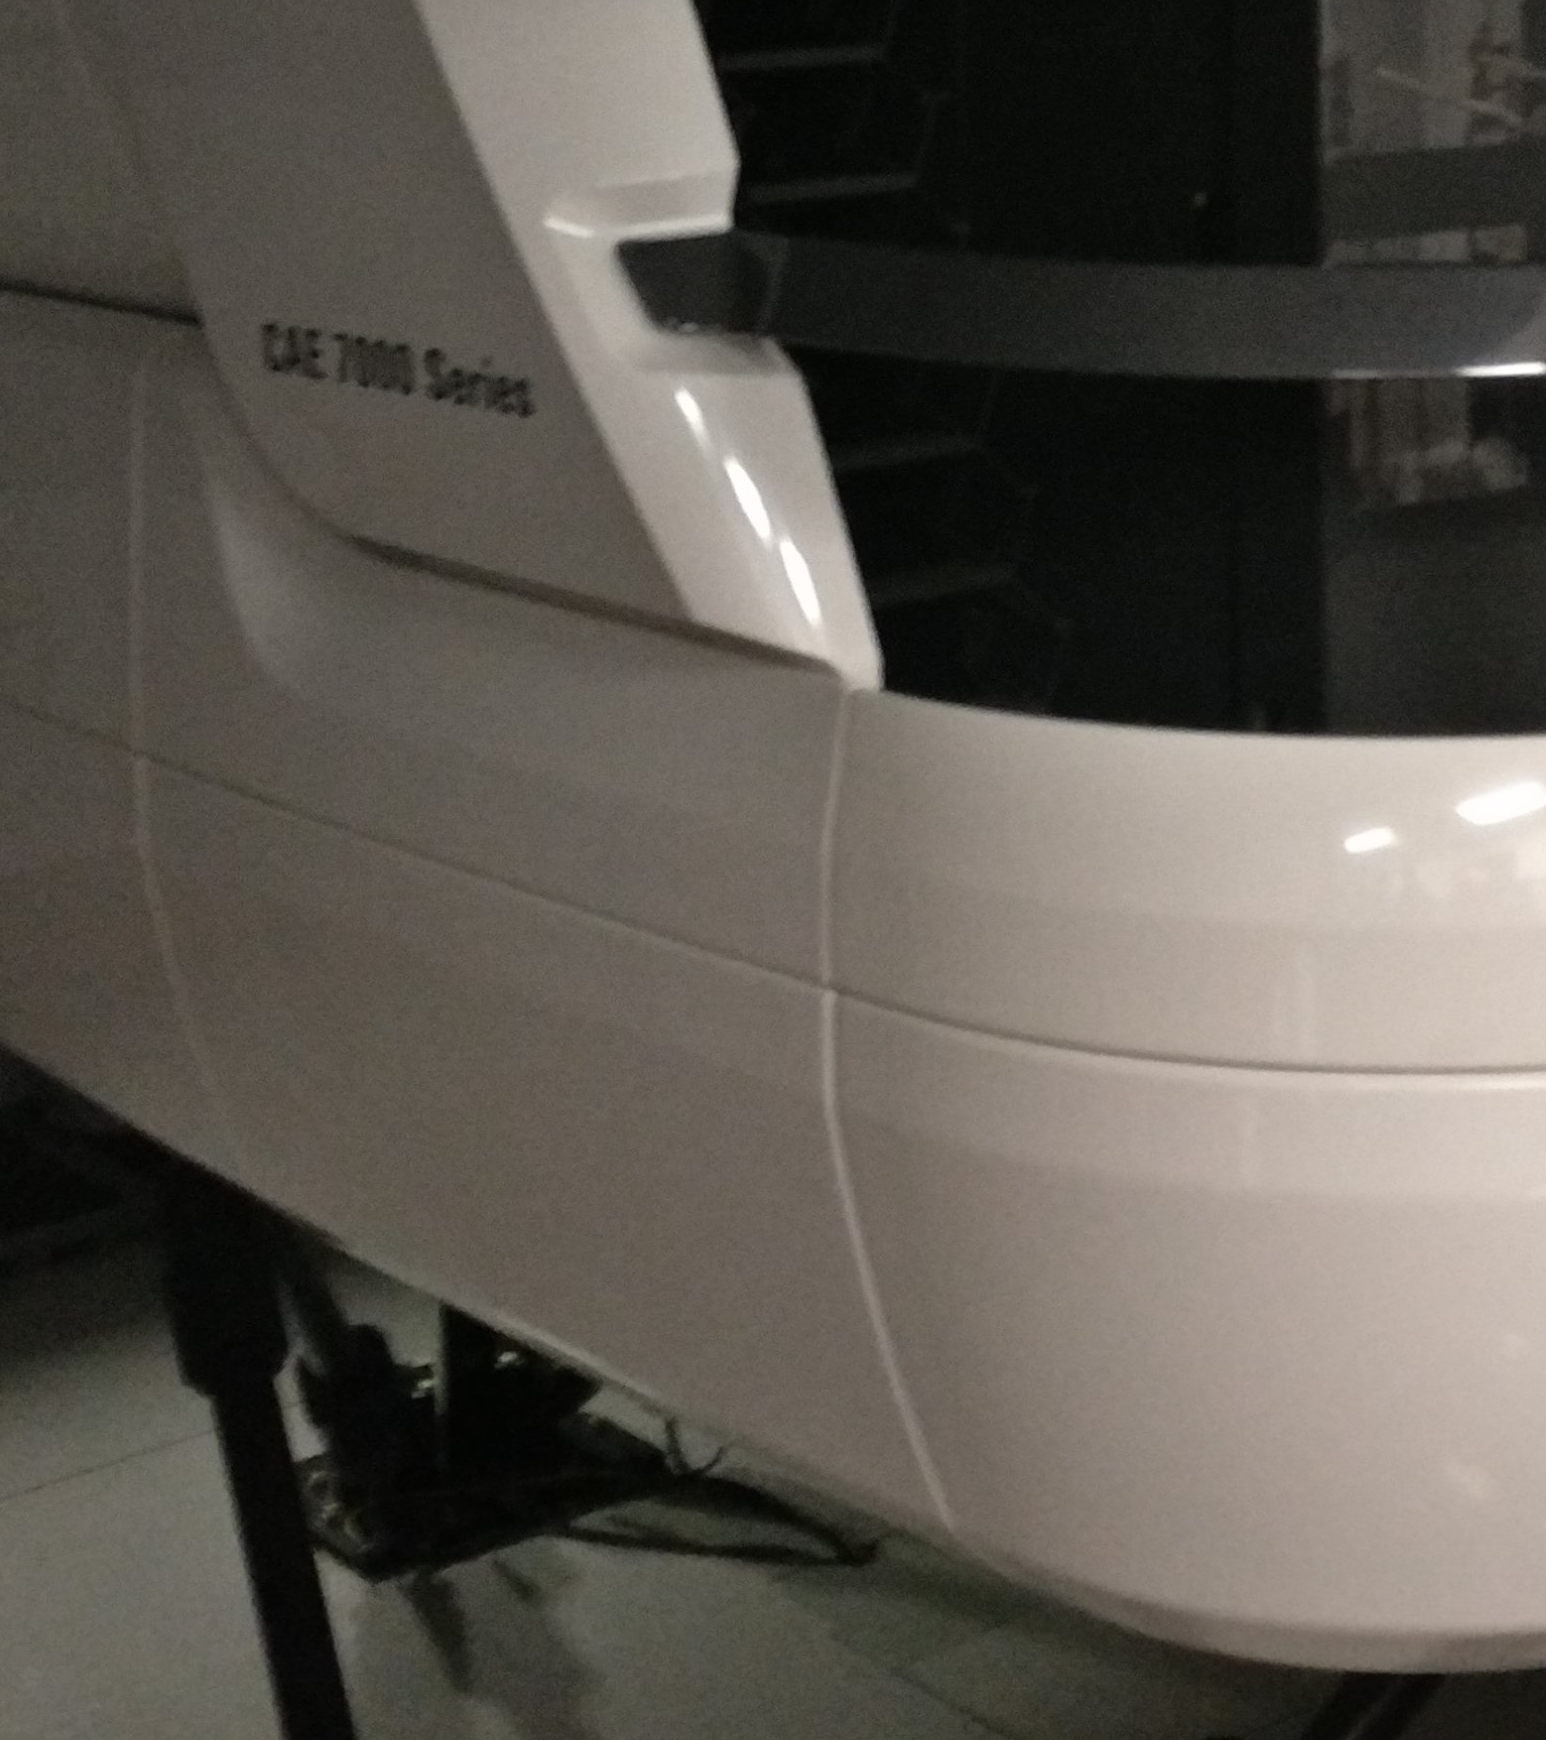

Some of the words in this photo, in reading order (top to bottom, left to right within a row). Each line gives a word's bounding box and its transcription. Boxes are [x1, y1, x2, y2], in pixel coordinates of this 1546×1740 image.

[260, 322, 328, 380] CAE
[331, 332, 415, 396] 7000
[422, 347, 536, 419] Series
